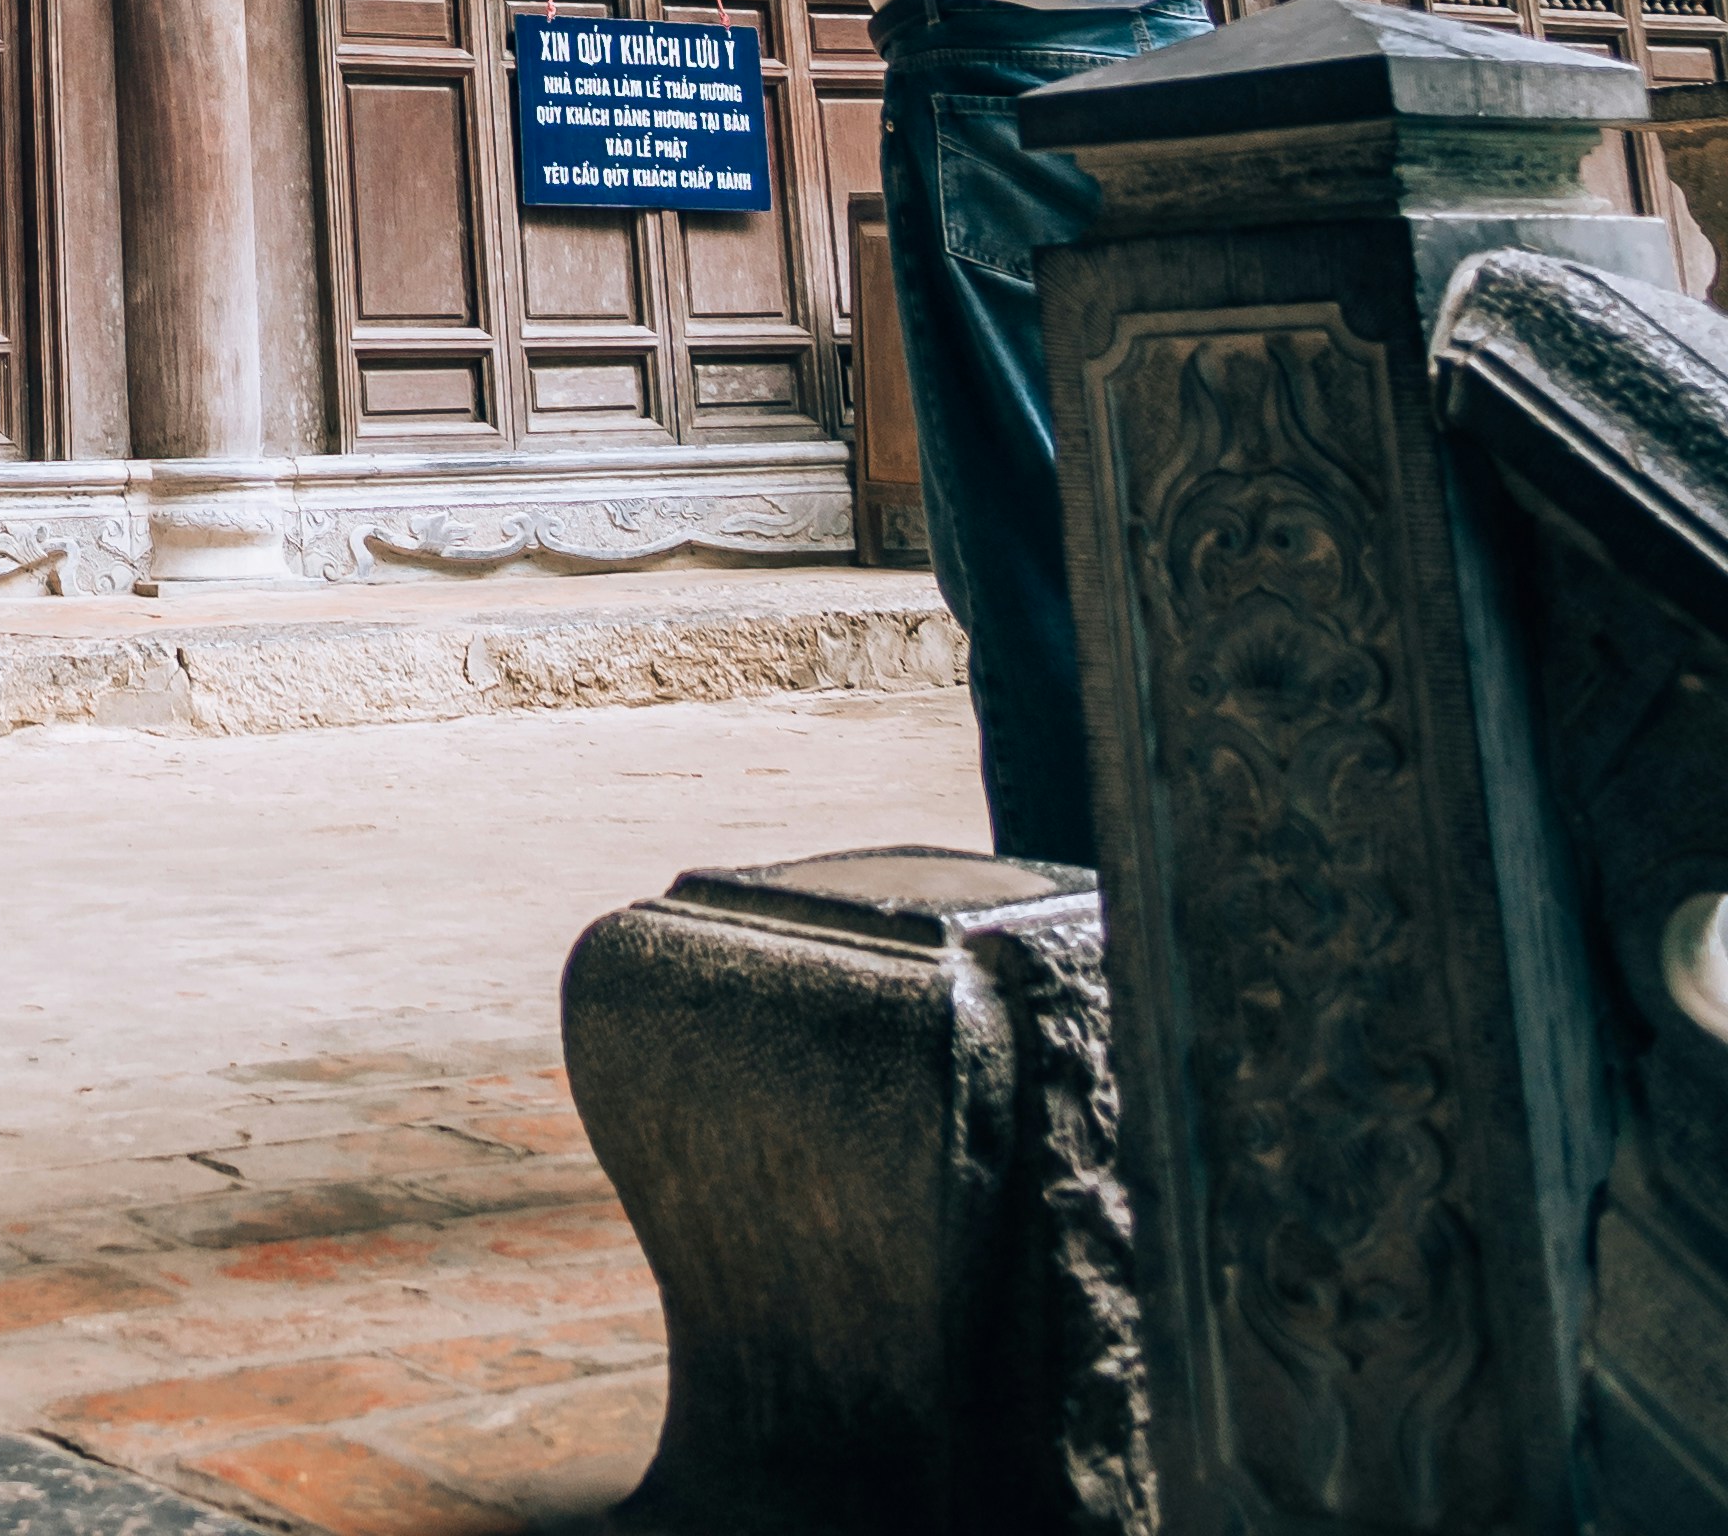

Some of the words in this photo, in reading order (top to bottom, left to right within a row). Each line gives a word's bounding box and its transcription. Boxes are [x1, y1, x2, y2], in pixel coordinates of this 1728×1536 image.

[539, 31, 569, 61] XIN
[621, 26, 680, 67] KHÁCH
[685, 33, 719, 68] LƯU
[725, 31, 735, 70] Ý
[544, 72, 572, 95] NHÀ
[576, 73, 611, 96] CHÙA
[614, 74, 642, 97] LÀM
[566, 104, 609, 126] KHÁCH
[606, 133, 632, 157] VÀO
[656, 137, 687, 162] PHẬT
[543, 162, 569, 185] YÊU
[633, 165, 677, 188] KHÁCH
[681, 165, 713, 189] CHẤP
[717, 166, 751, 191] HÀNH
